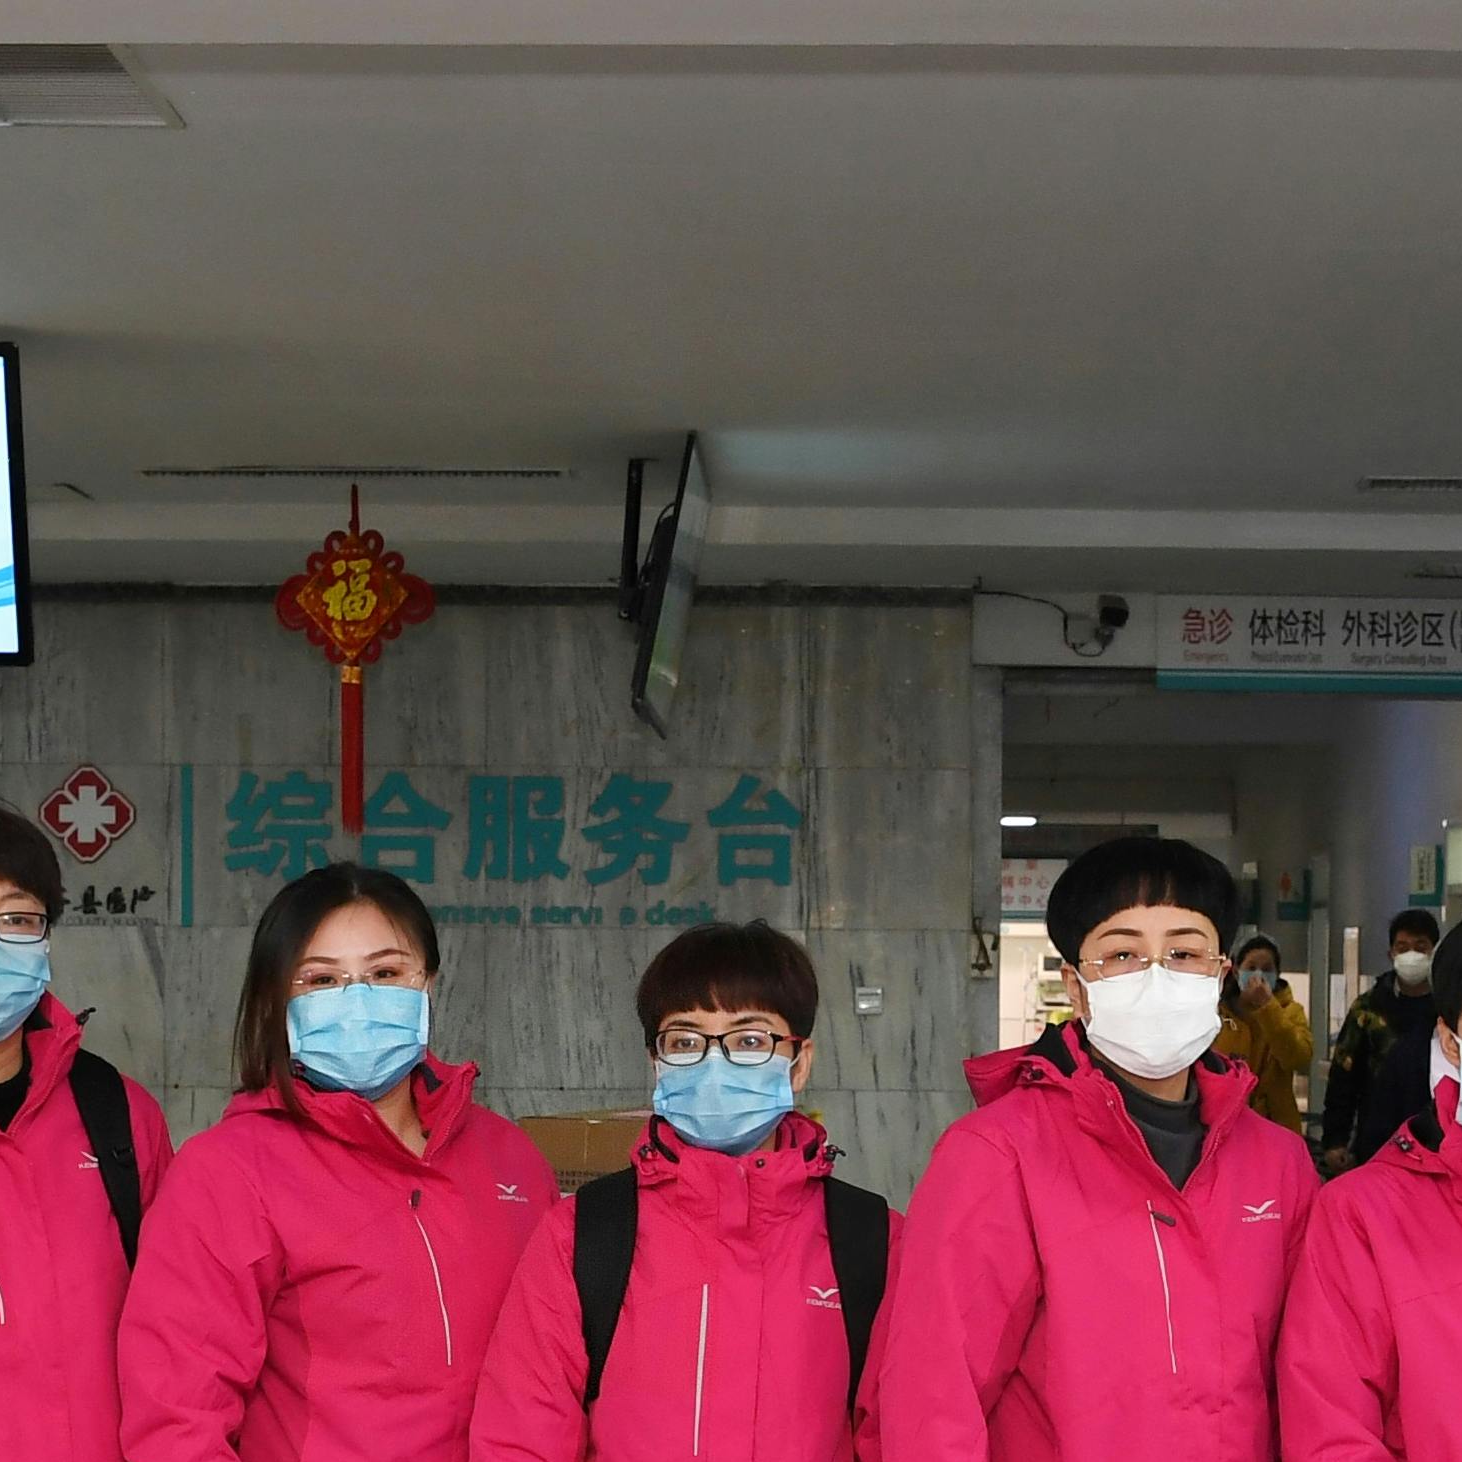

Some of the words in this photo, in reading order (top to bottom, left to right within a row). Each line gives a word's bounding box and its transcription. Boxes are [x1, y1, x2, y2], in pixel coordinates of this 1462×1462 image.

[322, 558, 378, 622] 福
[1181, 607, 1234, 645] 急诊
[1248, 608, 1326, 647] 体检科
[1341, 609, 1445, 648] 外科诊区
[224, 770, 804, 888] 综合服务台
